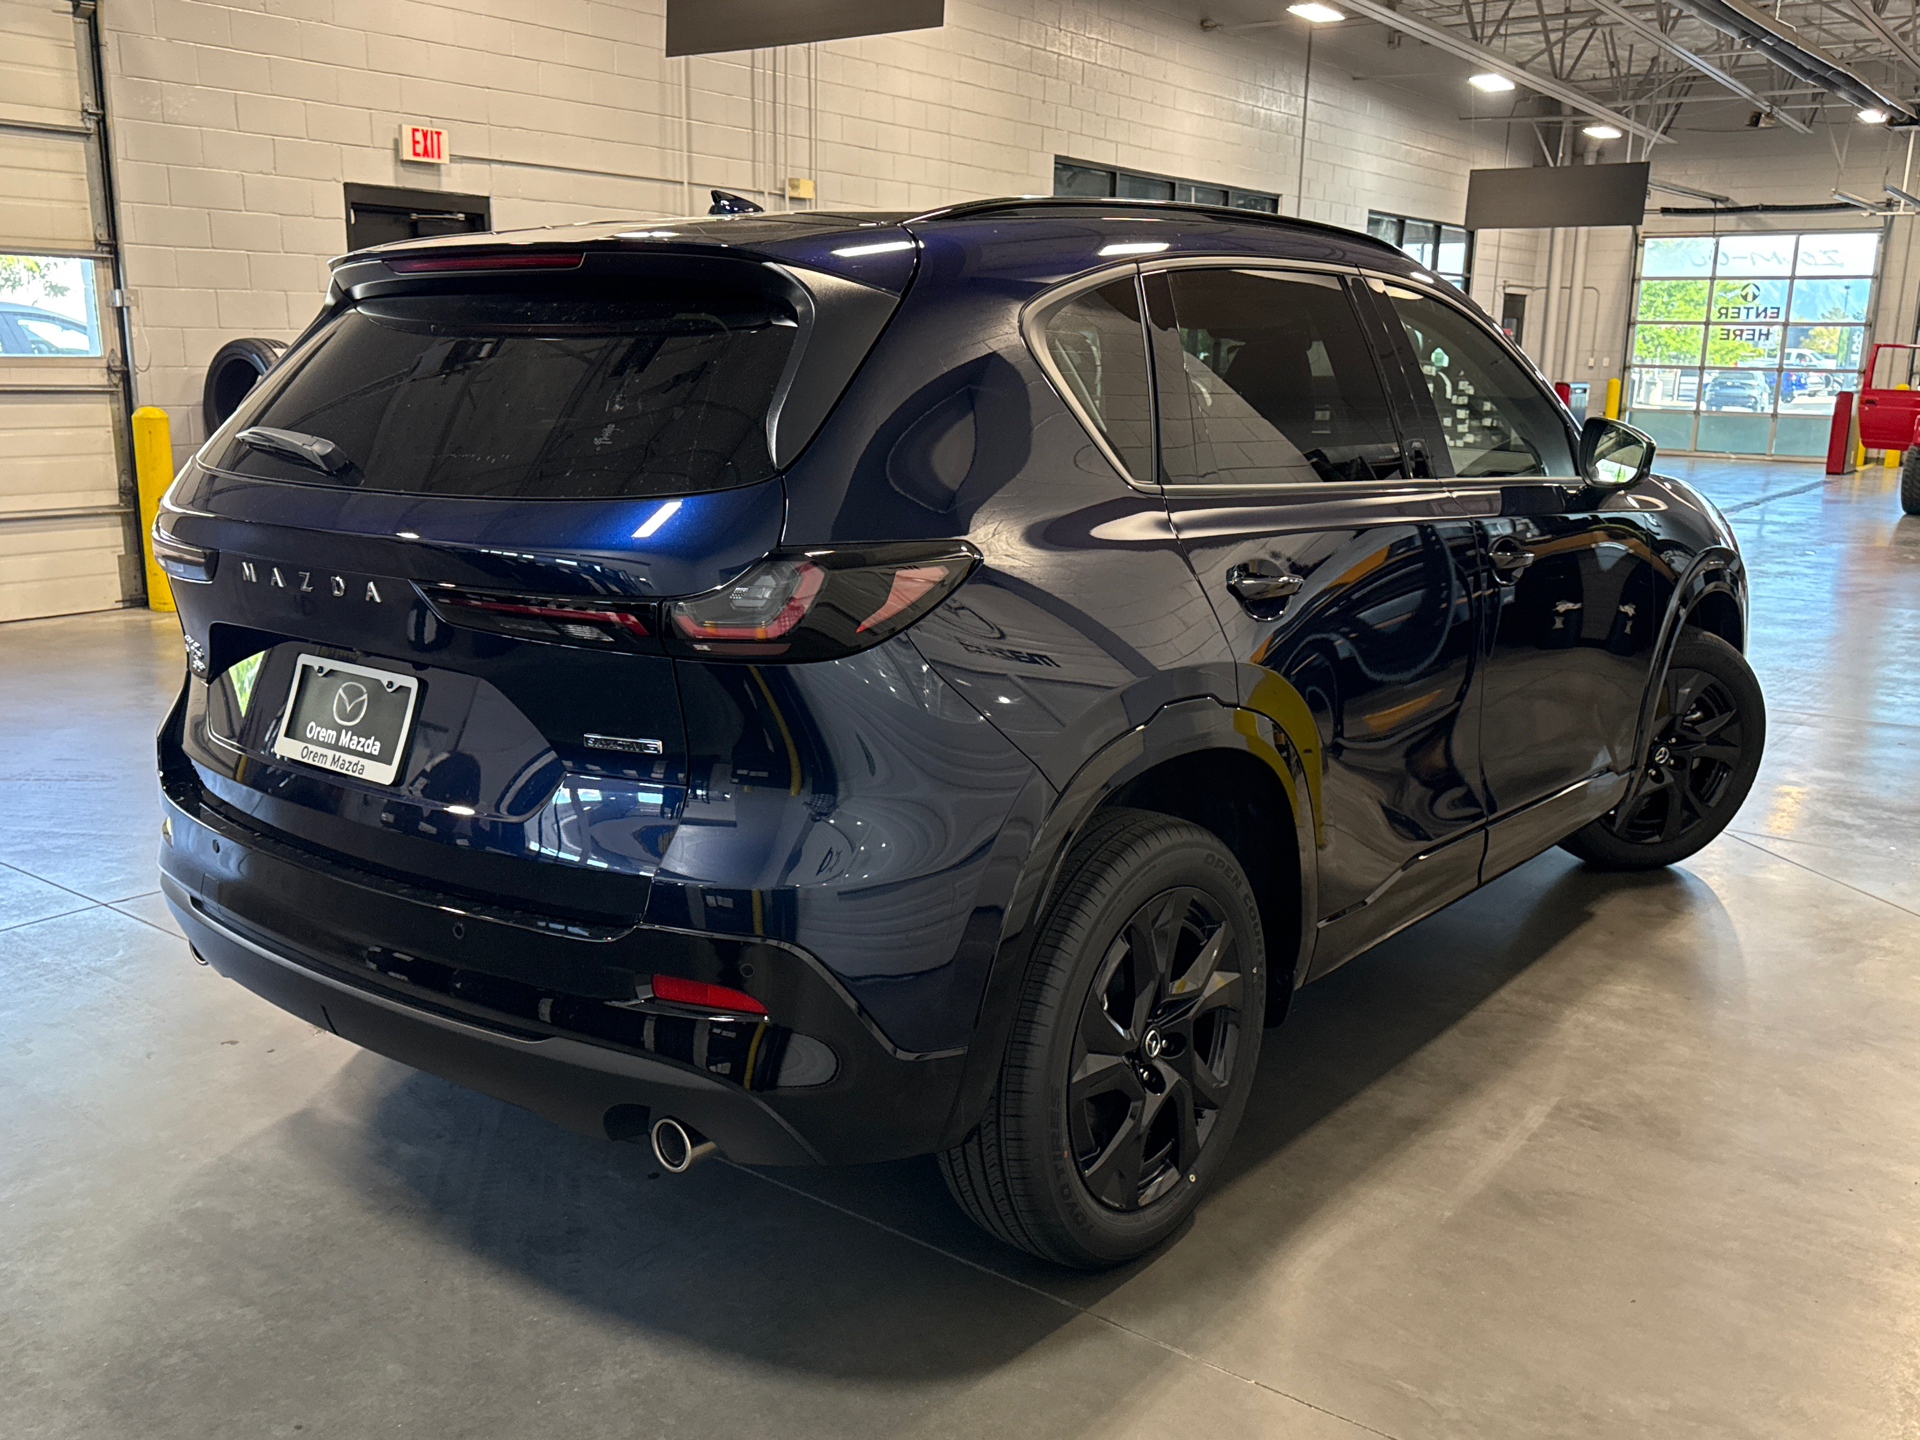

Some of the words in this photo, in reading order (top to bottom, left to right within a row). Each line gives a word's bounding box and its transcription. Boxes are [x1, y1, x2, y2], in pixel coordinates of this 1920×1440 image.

[411, 127, 442, 159] EXIT
[241, 561, 382, 603] MAZDA
[306, 721, 337, 745] Orem
[338, 729, 381, 756] Mazda
[301, 746, 328, 766] Orem
[330, 754, 365, 775] Mazda
[1203, 852, 1243, 890] OPEN
